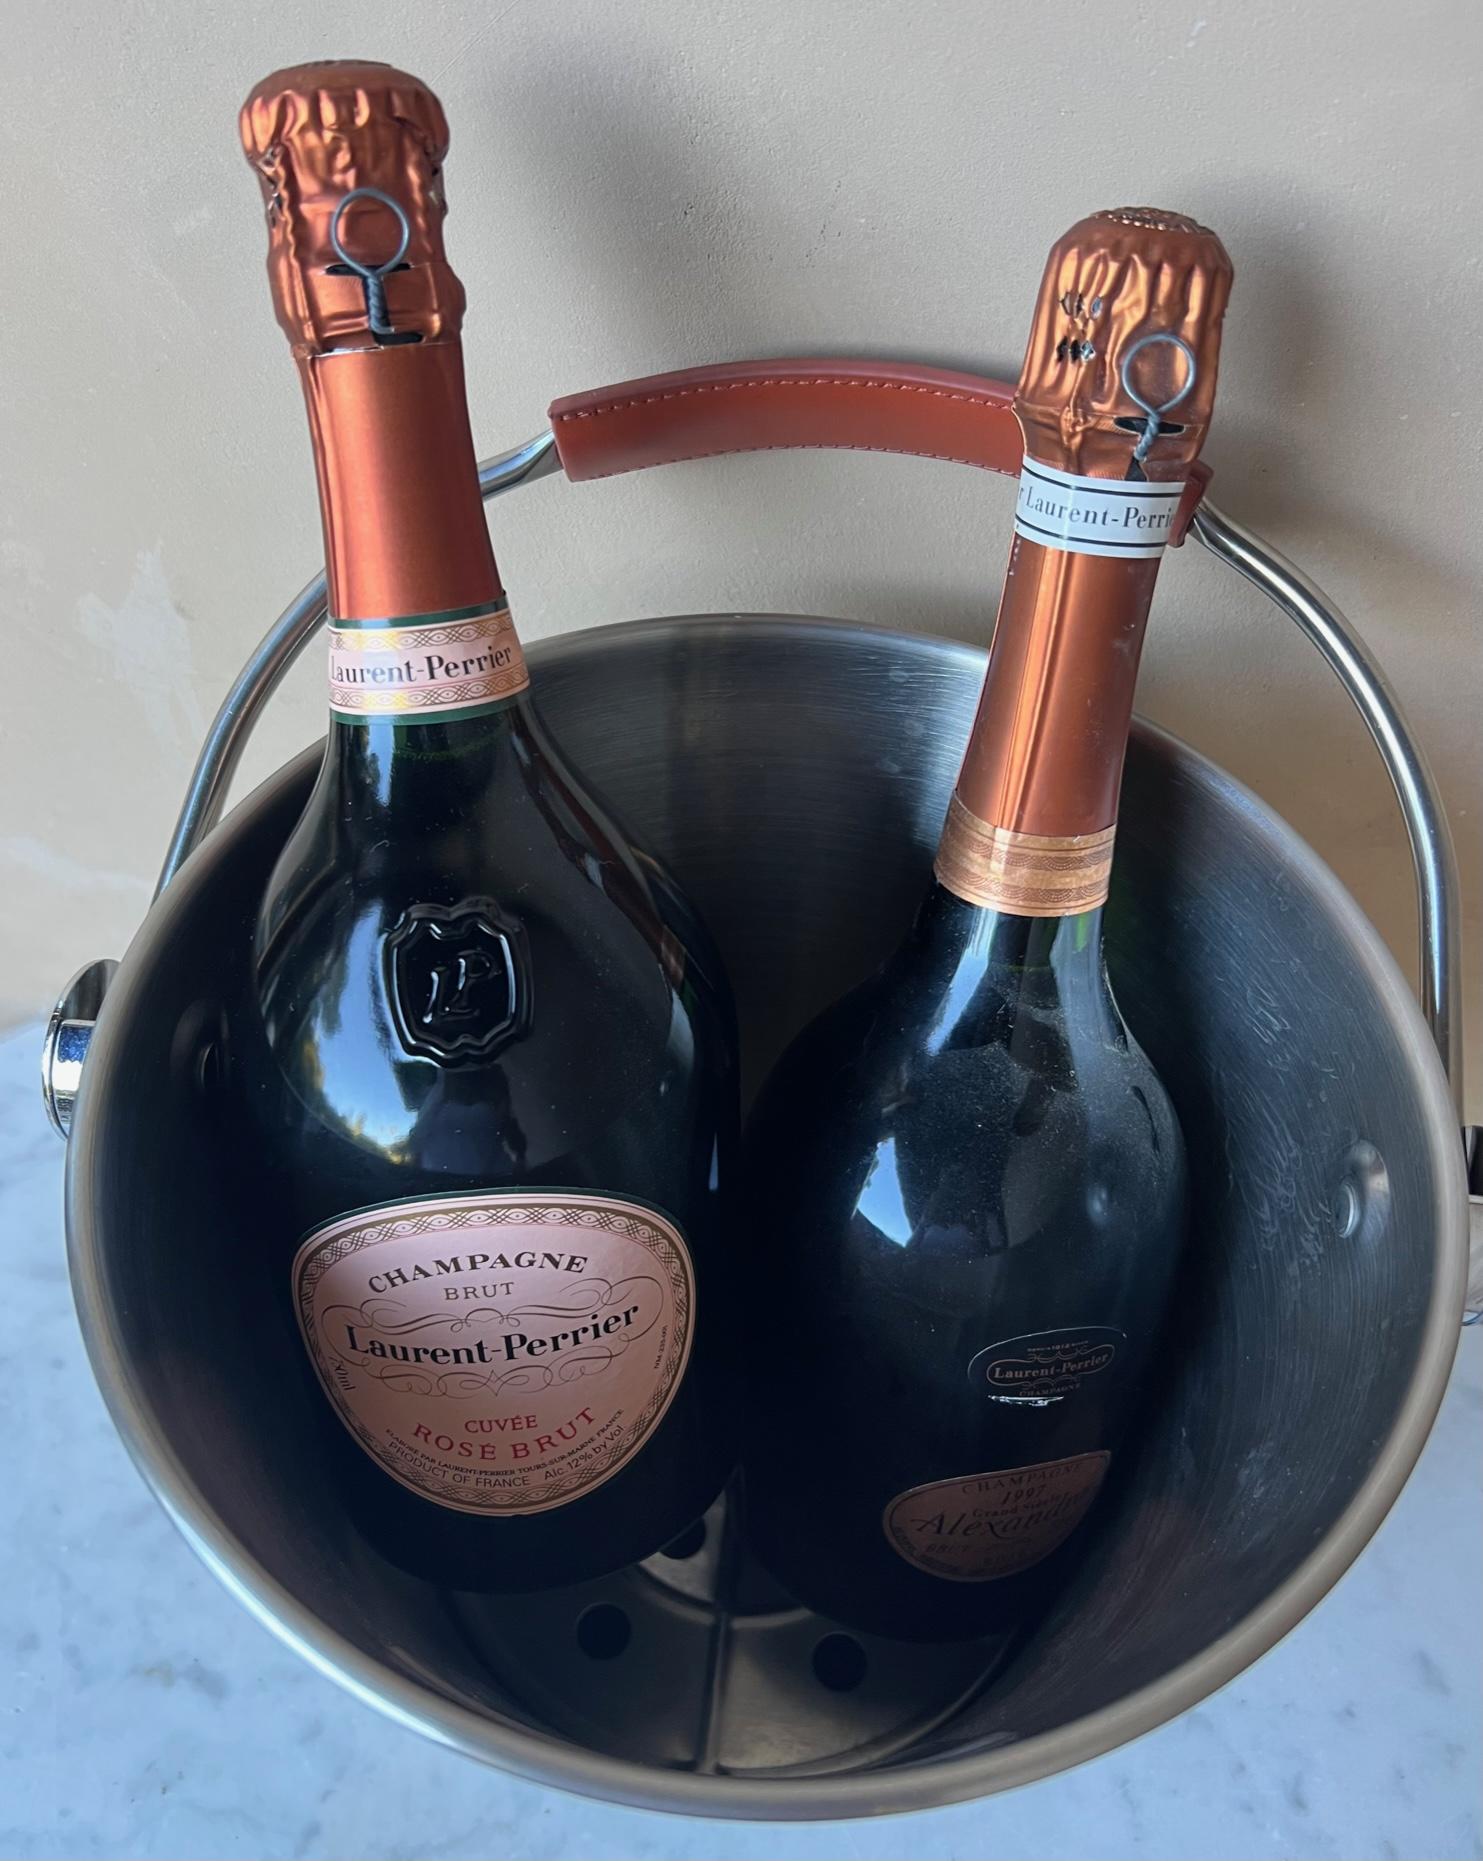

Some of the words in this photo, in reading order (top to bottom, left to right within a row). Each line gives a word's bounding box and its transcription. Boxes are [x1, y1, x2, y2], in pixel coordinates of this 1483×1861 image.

[331, 645, 512, 684] Laurent-Perrier
[368, 1251, 588, 1294] CHAMPAGNE
[444, 1281, 515, 1301] BRUT
[344, 1304, 639, 1365] Laurent-Perrier
[993, 1352, 1109, 1379] Laurent-Perrier
[1018, 1382, 1081, 1397] CHAMPAGNE
[413, 1422, 497, 1461] ROSÉ
[512, 1407, 595, 1460] BRUT
[464, 1414, 538, 1434] CUVÉE
[596, 1409, 625, 1437] FRANCE
[388, 1441, 449, 1479] PRODUCT
[452, 1473, 471, 1484] OF
[475, 1475, 530, 1488] FRANCE
[567, 1452, 593, 1470] 12%
[592, 1441, 608, 1455] by
[605, 1425, 625, 1442] Vol
[962, 1463, 1083, 1495] CHAMPAGNE
